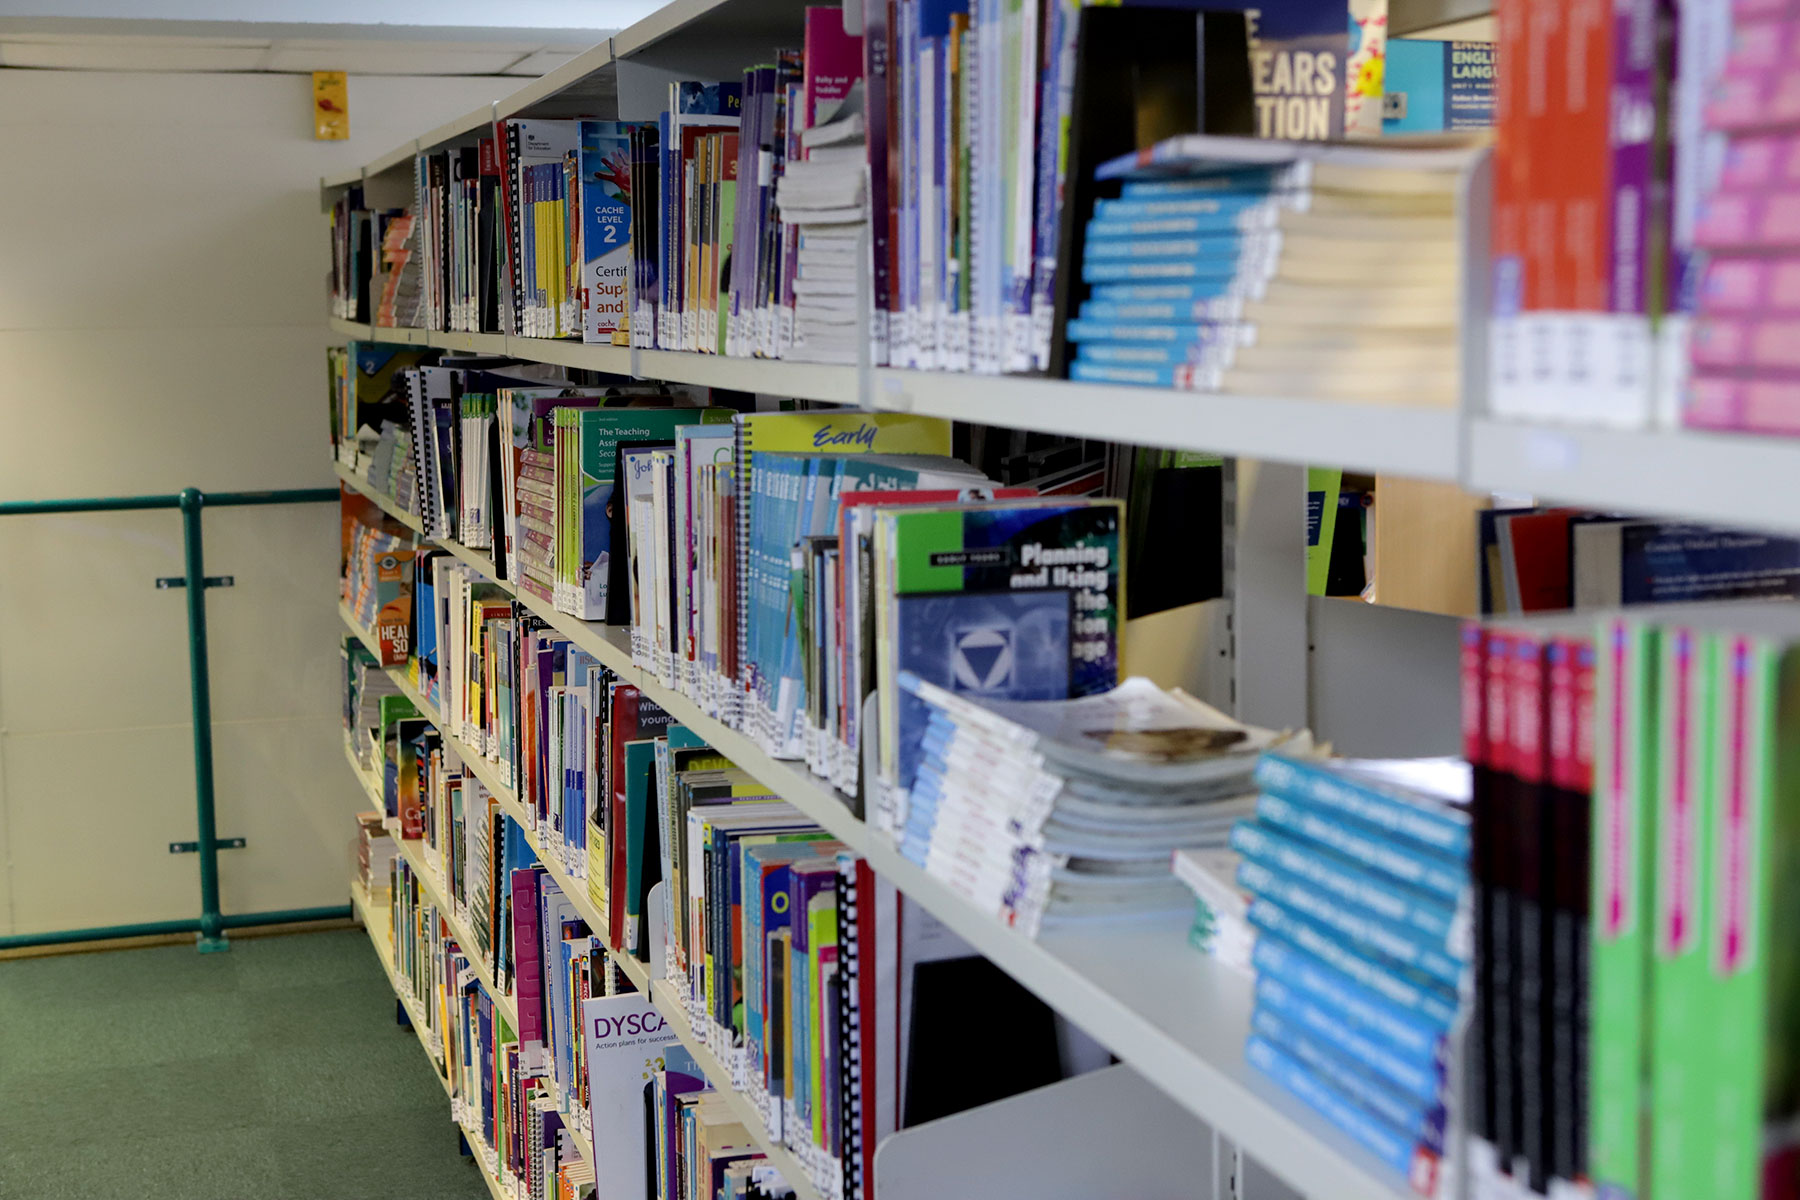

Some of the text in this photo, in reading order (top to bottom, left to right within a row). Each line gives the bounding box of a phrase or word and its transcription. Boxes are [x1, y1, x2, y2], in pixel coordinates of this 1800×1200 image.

[1452, 51, 1499, 64] ENGLI
[1249, 50, 1337, 96] EARS
[727, 95, 742, 108] Pe
[1254, 96, 1329, 140] TION
[595, 206, 624, 214] CACHE
[597, 216, 623, 224] LEVEL
[603, 225, 617, 243] 2
[595, 265, 628, 277] Certif
[596, 282, 624, 298] Sup
[596, 300, 624, 313] and
[598, 428, 650, 437] The Teaching
[813, 423, 878, 449] Early
[598, 450, 616, 458] Seco
[1020, 541, 1109, 568] Planning
[1009, 564, 1109, 592] and Using
[1072, 612, 1109, 635] ion
[393, 638, 408, 653] SO
[640, 715, 675, 728] young
[688, 757, 729, 771] DEV
[405, 807, 421, 821] Ca
[595, 1033, 679, 1050] Action plans for successf
